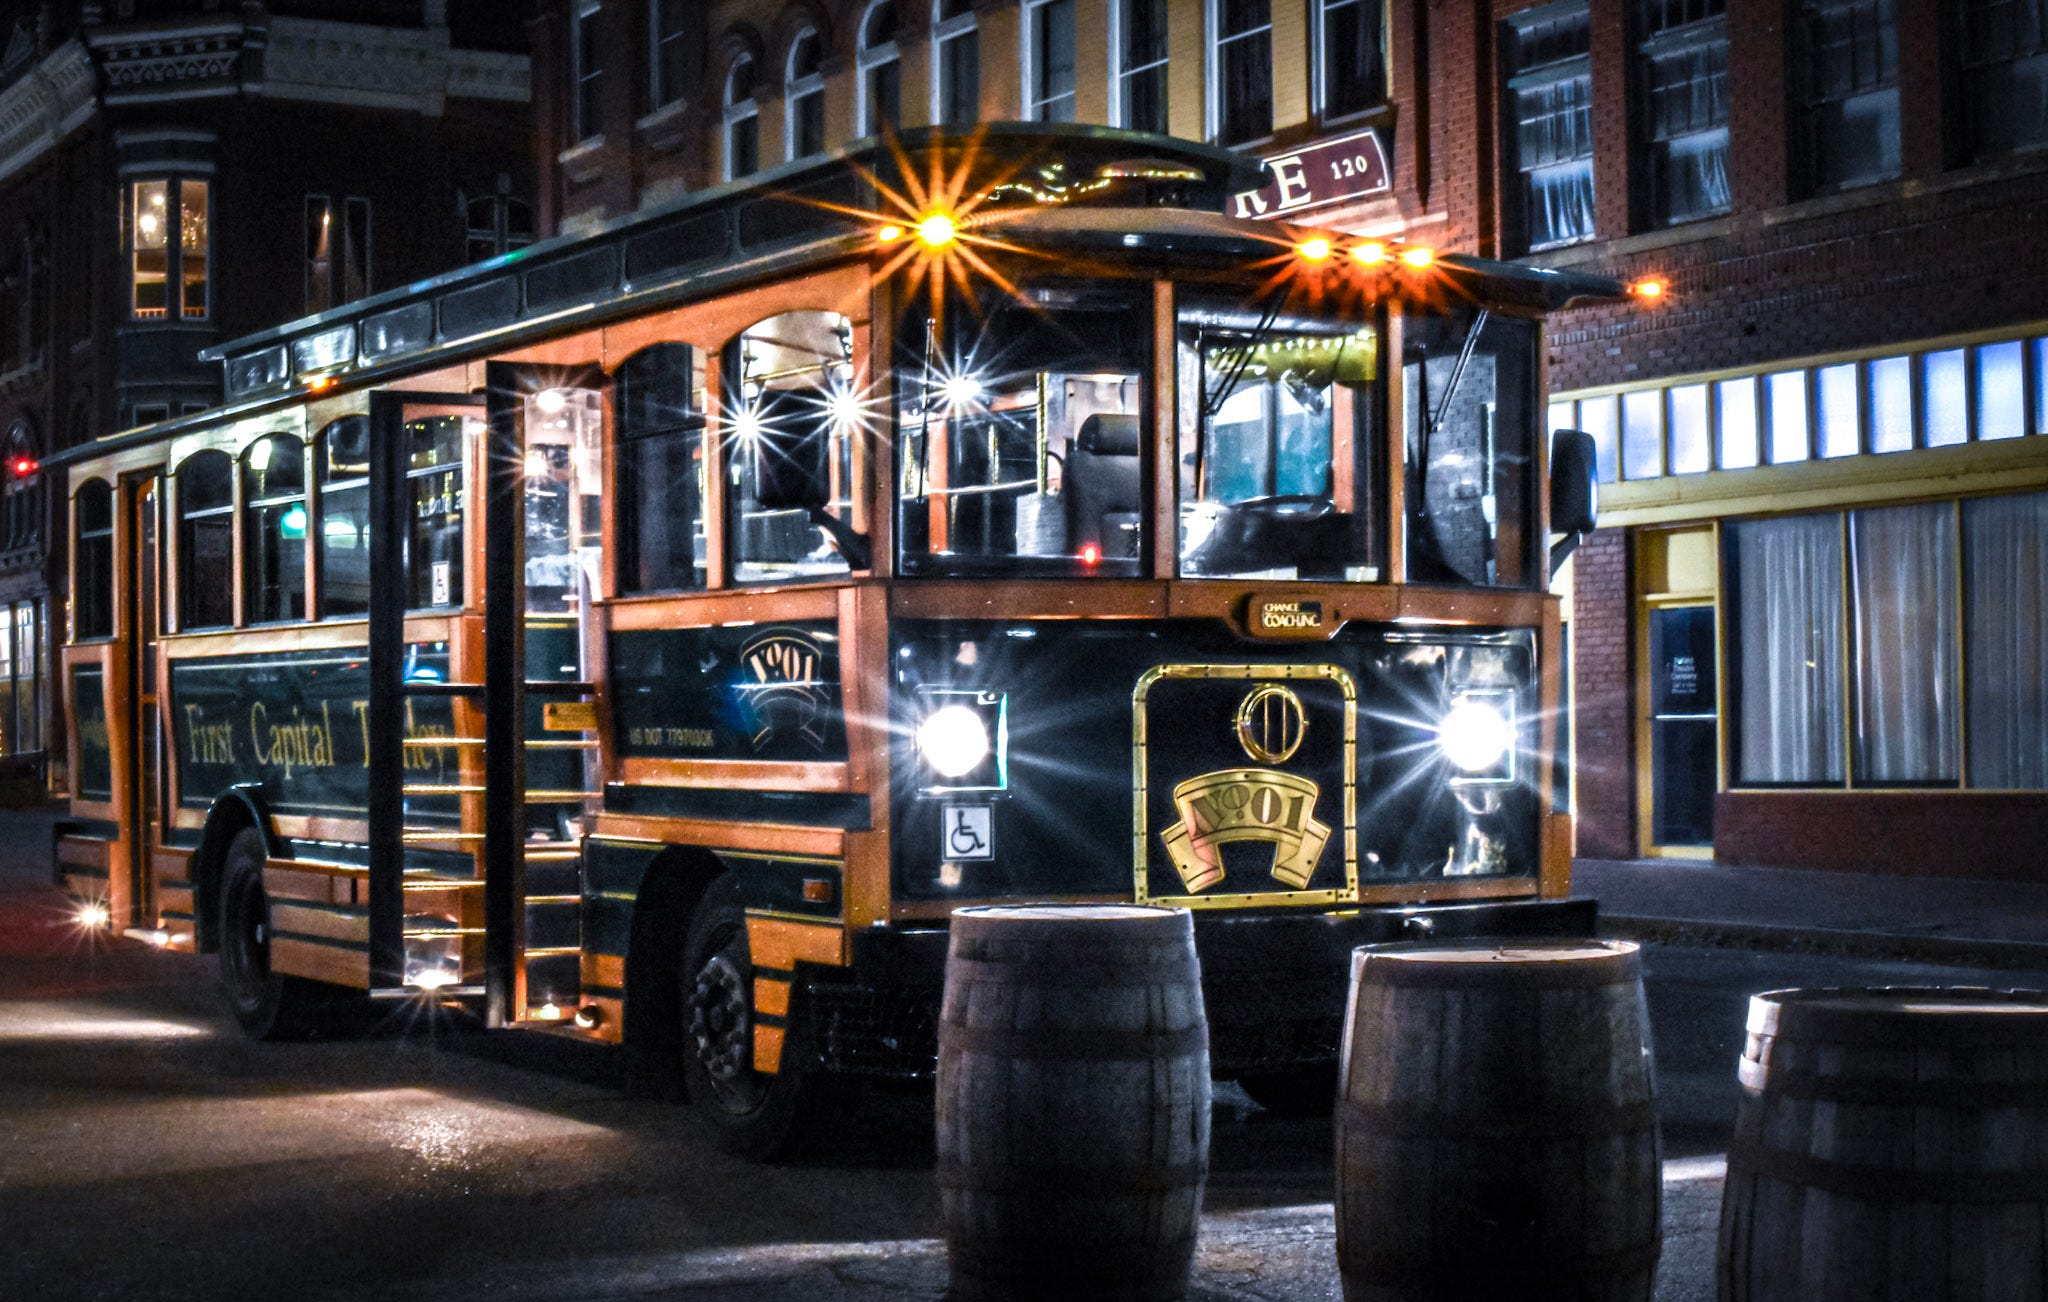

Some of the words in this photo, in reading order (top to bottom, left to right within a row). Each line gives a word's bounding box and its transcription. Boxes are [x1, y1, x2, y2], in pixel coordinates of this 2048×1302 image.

[1331, 155, 1368, 180] 120
[1264, 603, 1300, 612] CHANCE
[185, 703, 237, 764] First
[250, 699, 336, 781] Capital
[352, 696, 447, 785] Tley
